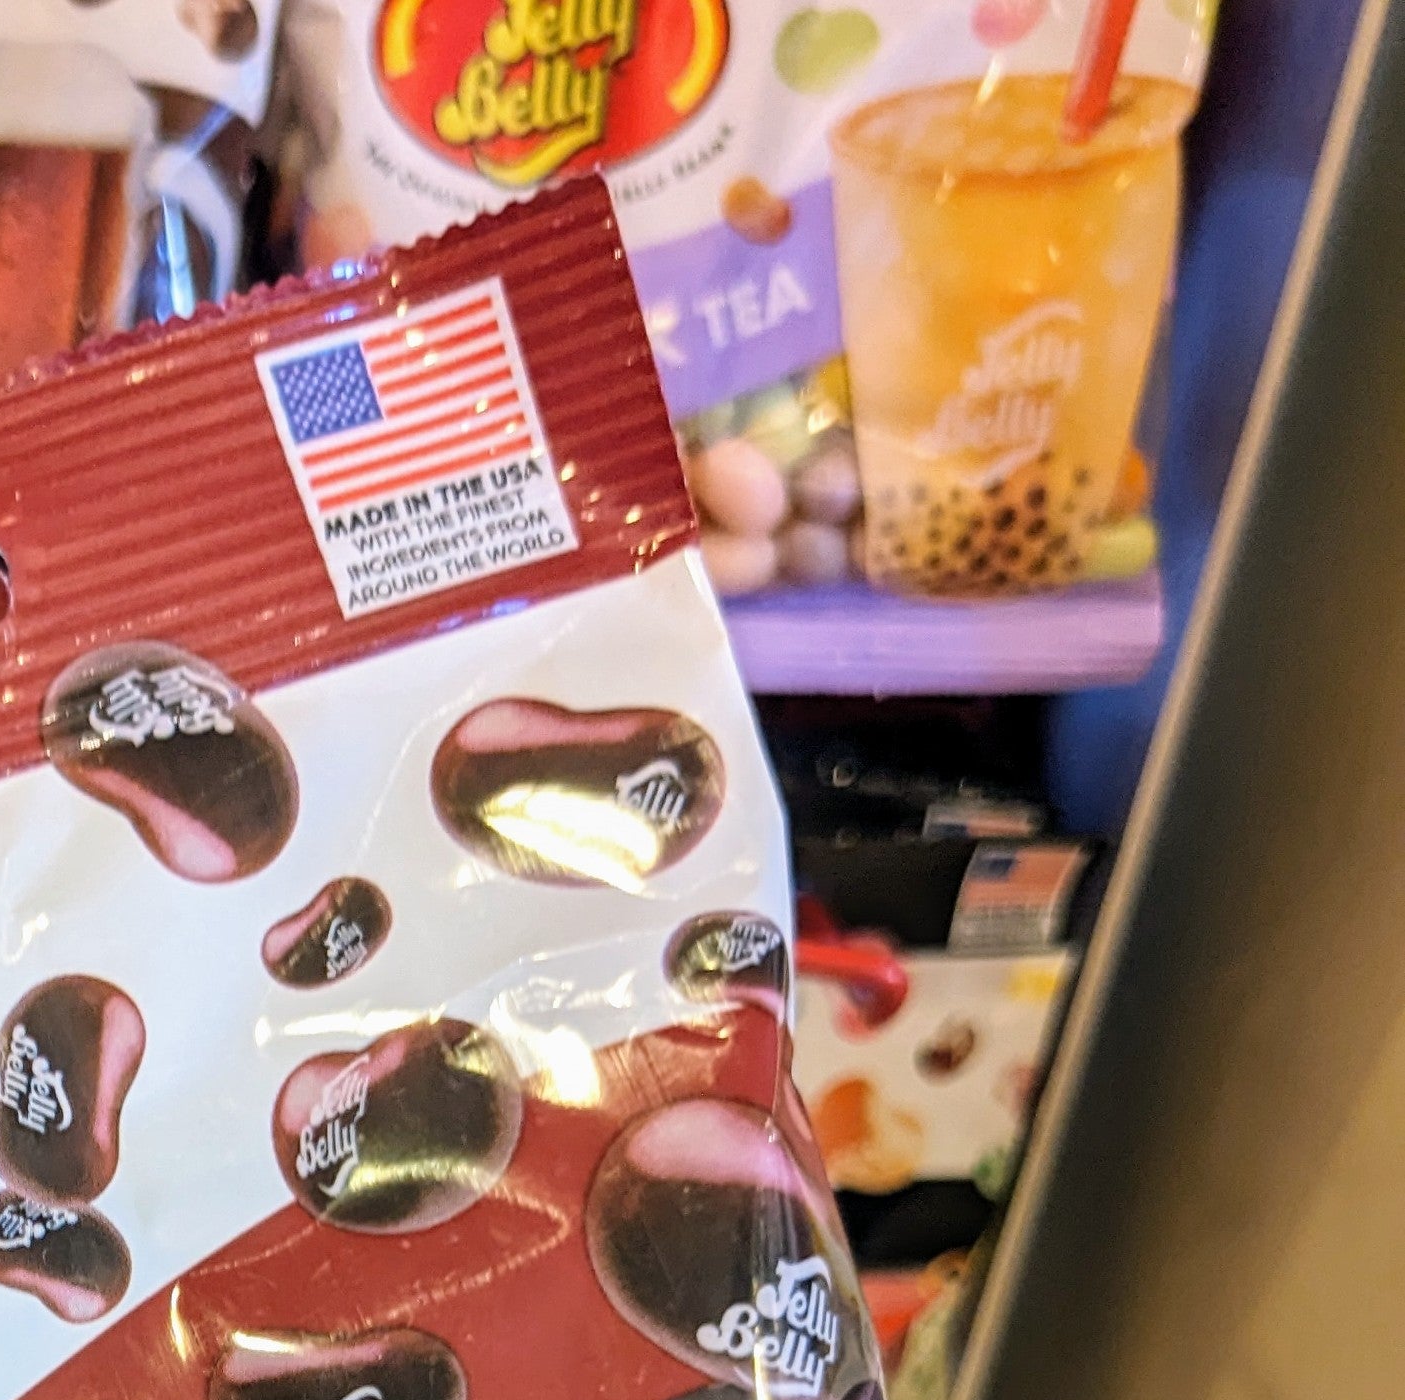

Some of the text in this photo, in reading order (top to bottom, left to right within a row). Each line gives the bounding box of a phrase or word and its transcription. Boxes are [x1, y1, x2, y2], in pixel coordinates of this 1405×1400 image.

[432, 54, 610, 187] Belly
[698, 262, 815, 350] TEA
[324, 458, 543, 541] MADE IN THE USA
[351, 488, 526, 555] WITH THE FINEST
[346, 508, 550, 583] INGREDIENTS FROM
[347, 527, 566, 611] AROUND THE WORLD
[296, 1117, 360, 1199] Belly
[695, 1302, 827, 1398] Belly
[755, 1254, 839, 1364] Jelly
